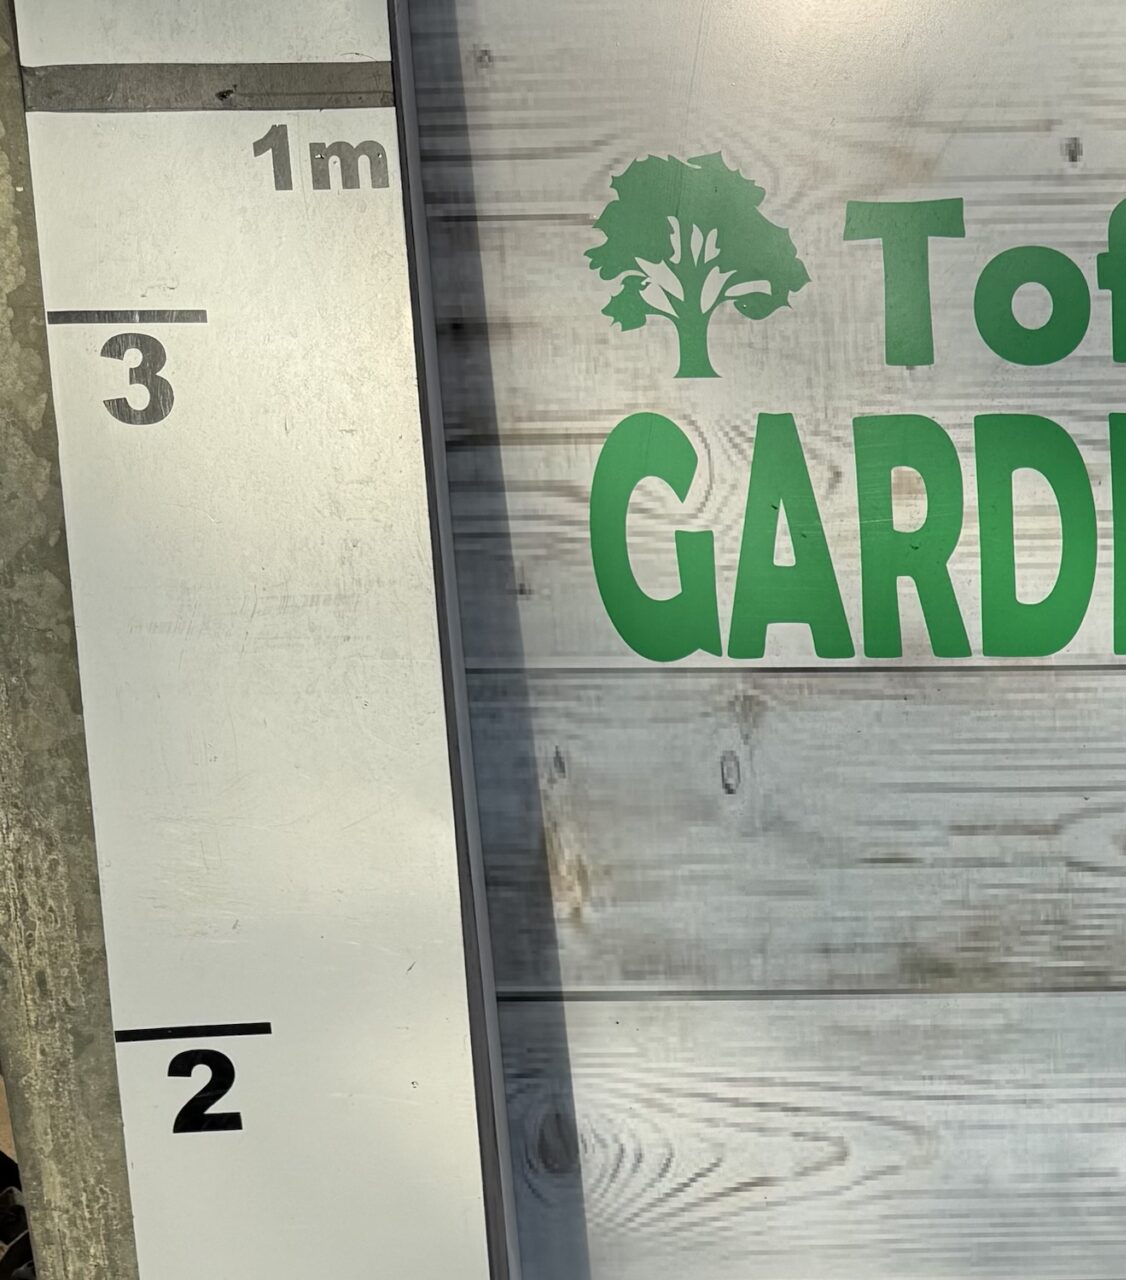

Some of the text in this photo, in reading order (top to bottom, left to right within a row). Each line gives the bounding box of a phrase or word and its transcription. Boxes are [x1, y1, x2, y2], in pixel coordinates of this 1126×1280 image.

[253, 125, 390, 191] 1m
[100, 333, 175, 426] 3
[167, 1049, 243, 1134] 2
